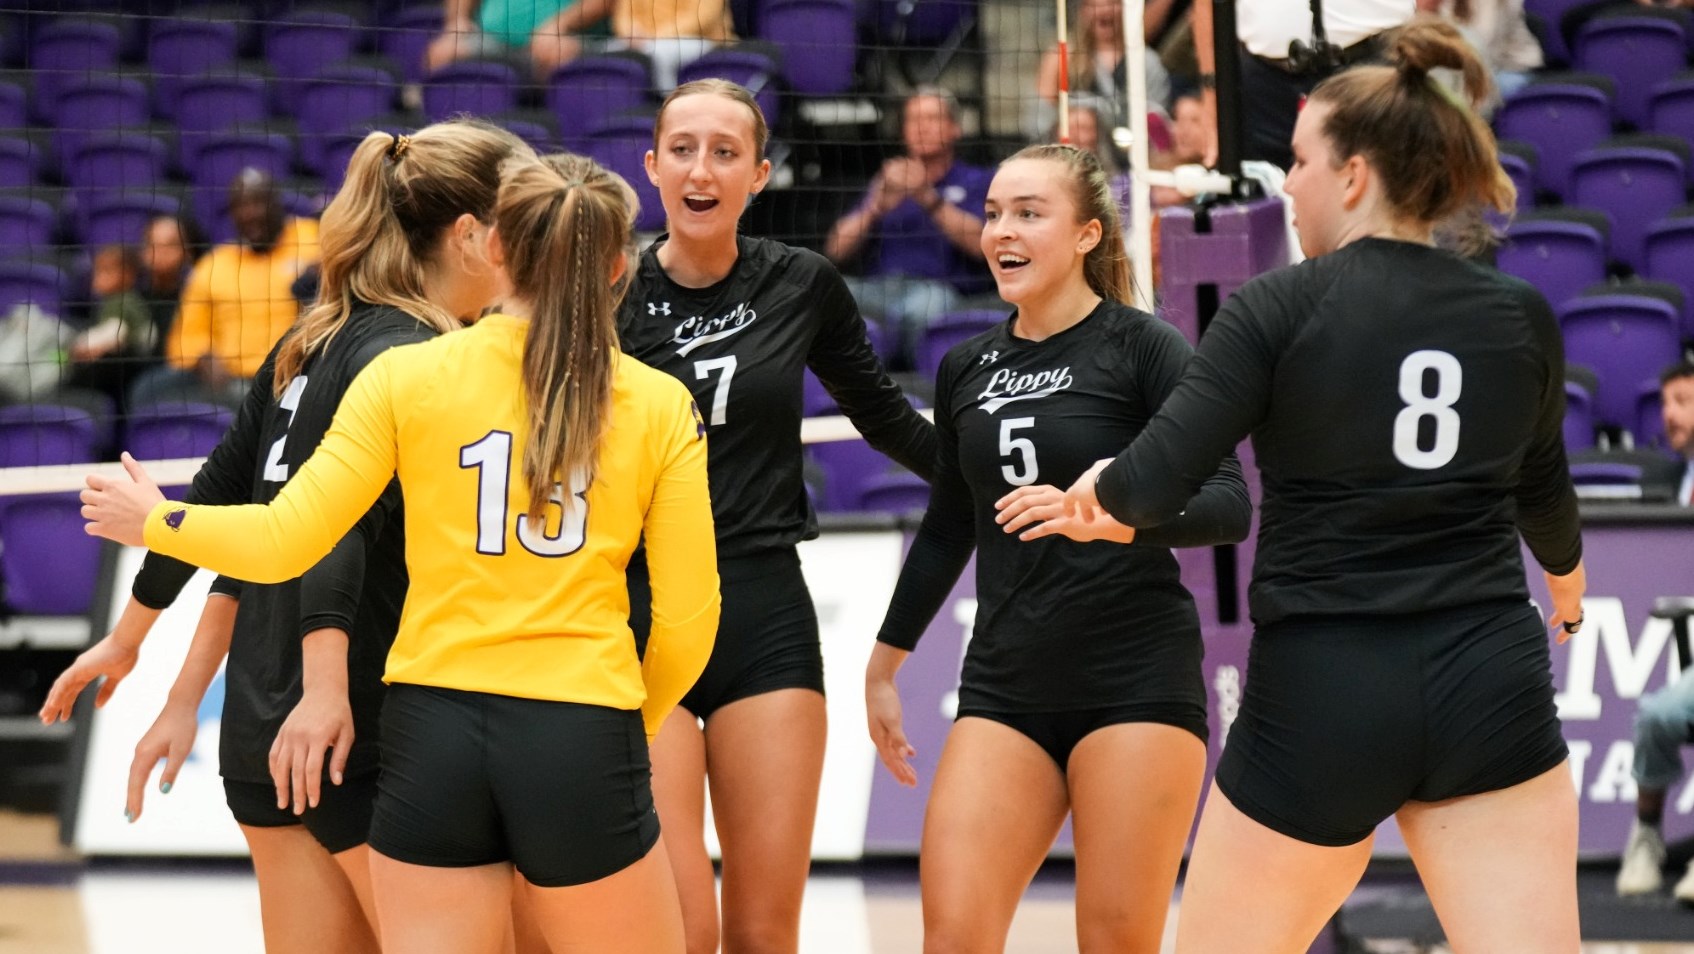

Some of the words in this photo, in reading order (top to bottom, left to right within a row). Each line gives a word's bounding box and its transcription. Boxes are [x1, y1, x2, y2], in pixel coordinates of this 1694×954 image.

[263, 375, 308, 482] 2
[693, 354, 738, 426] 7
[977, 366, 1073, 415] Lippy
[1392, 349, 1463, 470] 8
[459, 429, 593, 558] 13
[999, 416, 1039, 487] 5
